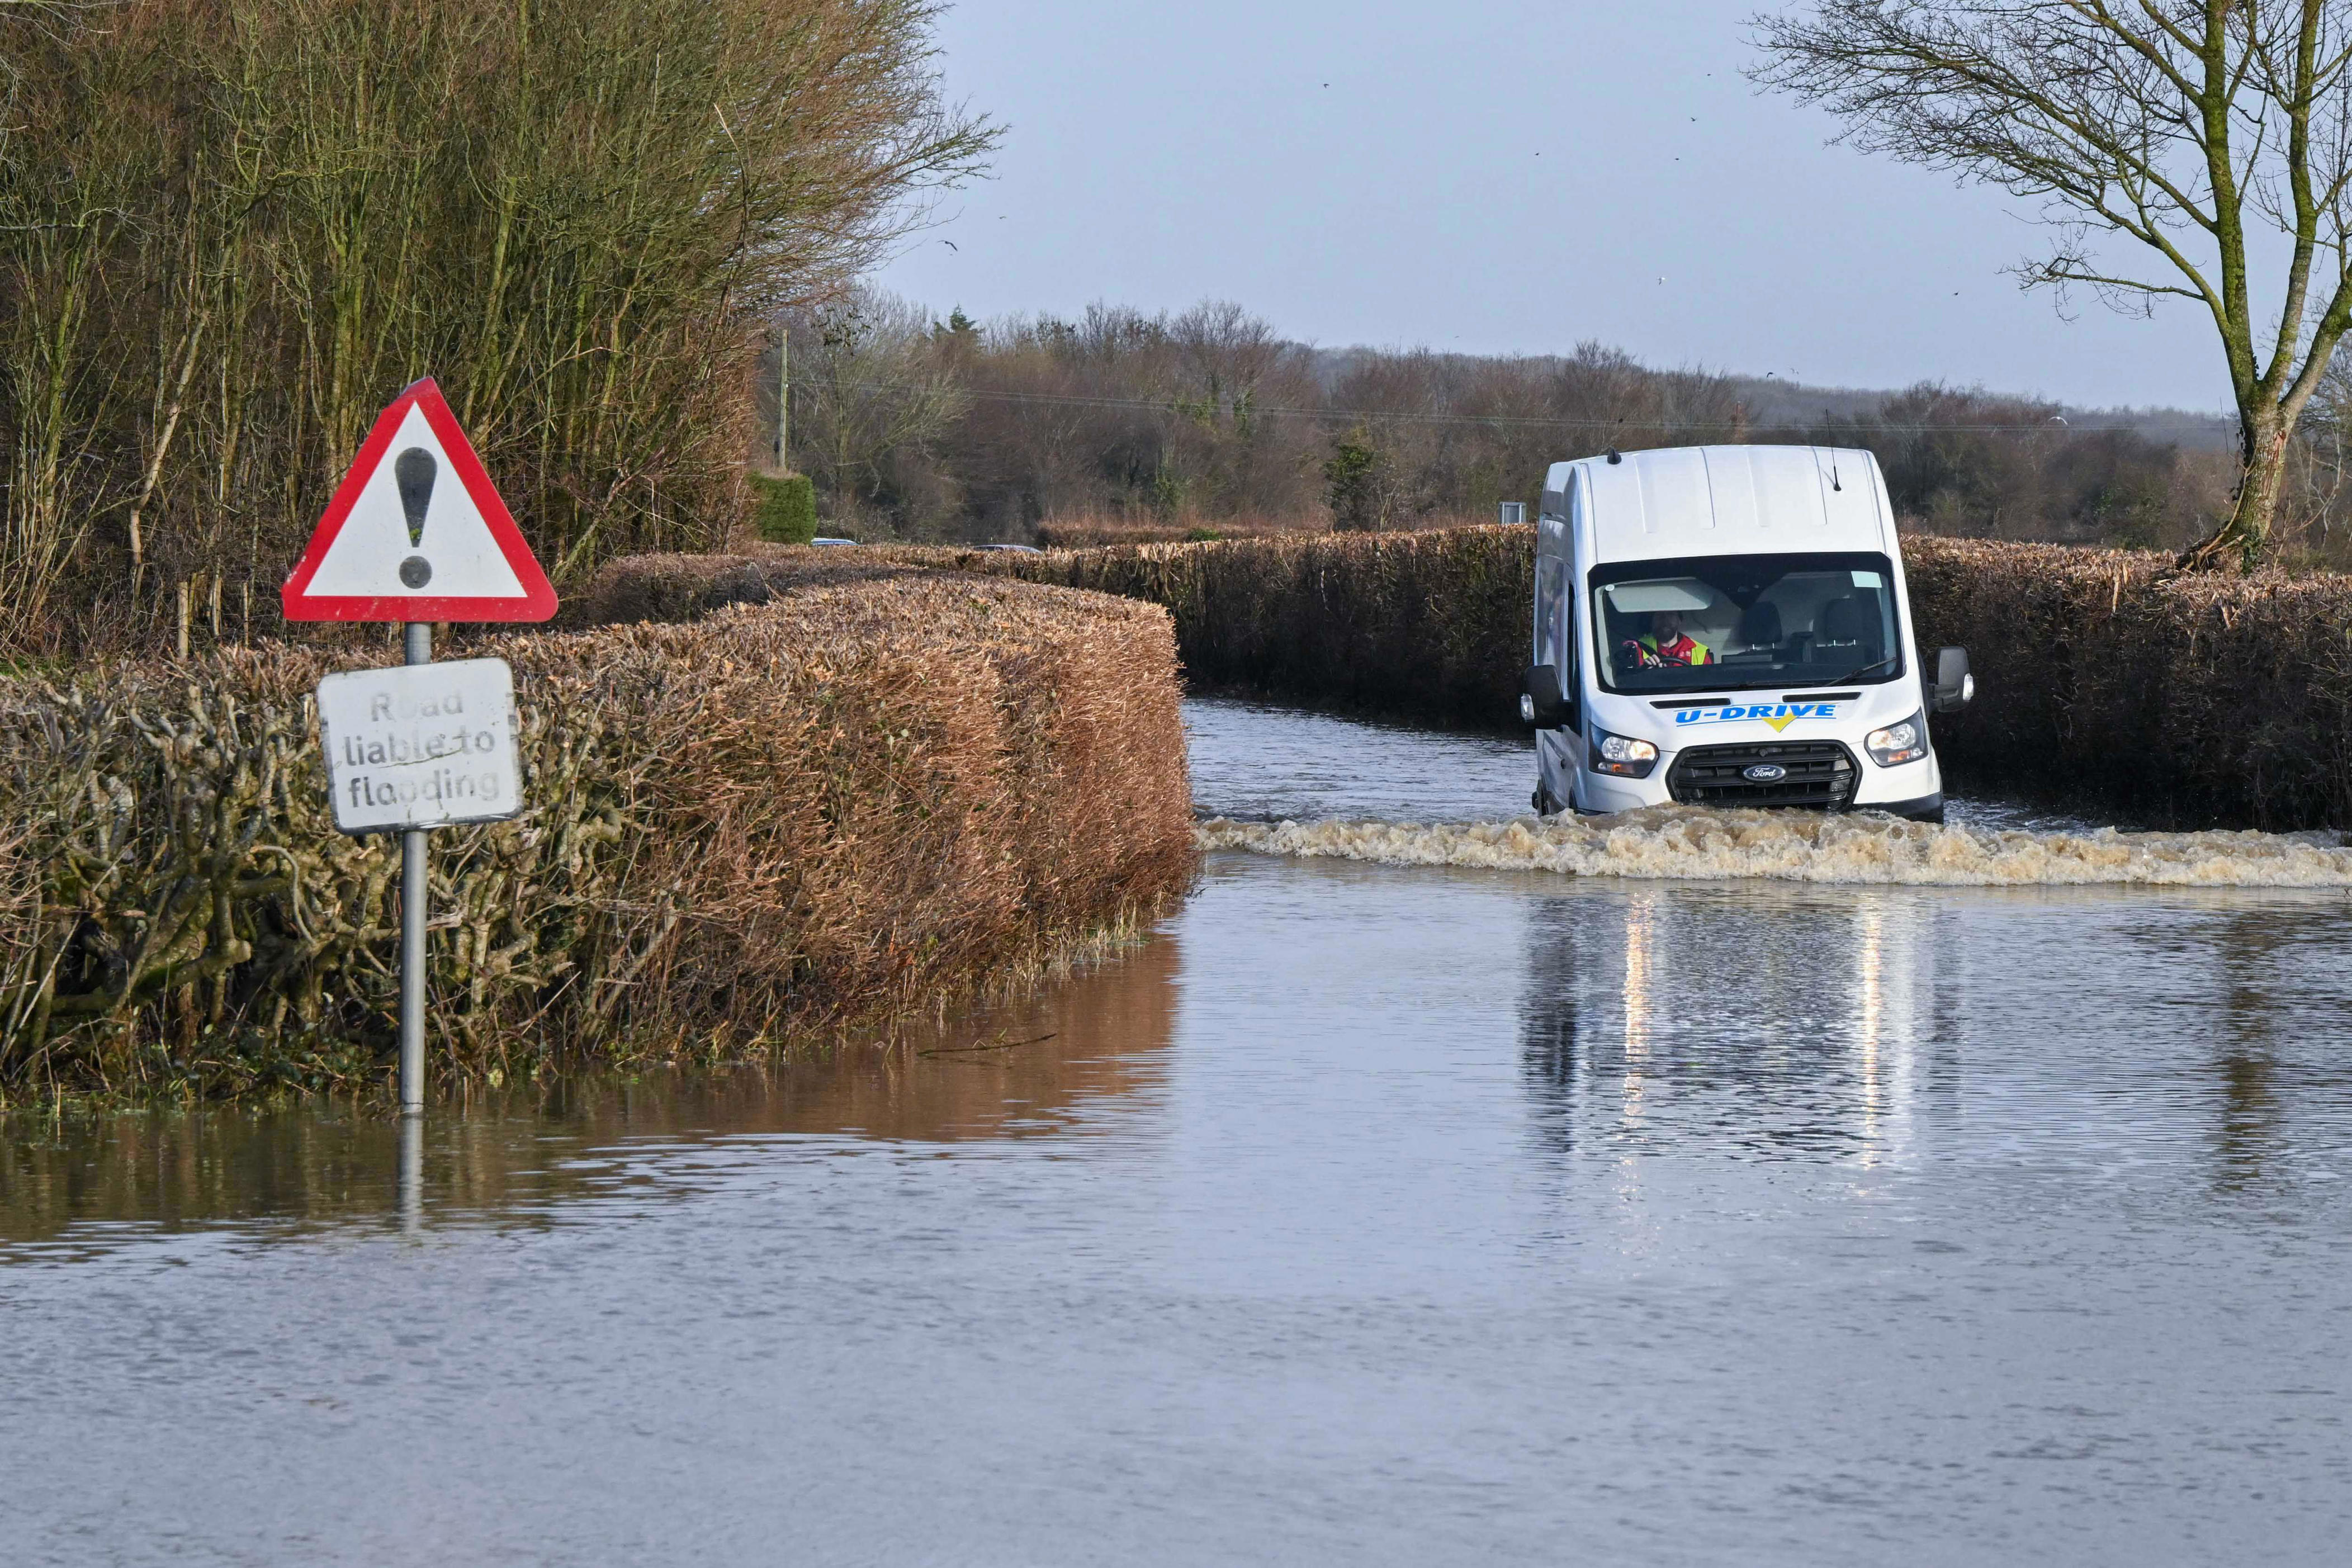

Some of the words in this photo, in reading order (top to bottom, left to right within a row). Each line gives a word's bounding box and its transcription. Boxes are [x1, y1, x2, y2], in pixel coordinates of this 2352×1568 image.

[1676, 705, 1836, 723] U-DRIVE
[344, 728, 446, 766] liable
[453, 725, 495, 755] to
[1753, 768, 1776, 777] Ford
[348, 769, 500, 808] flooding
